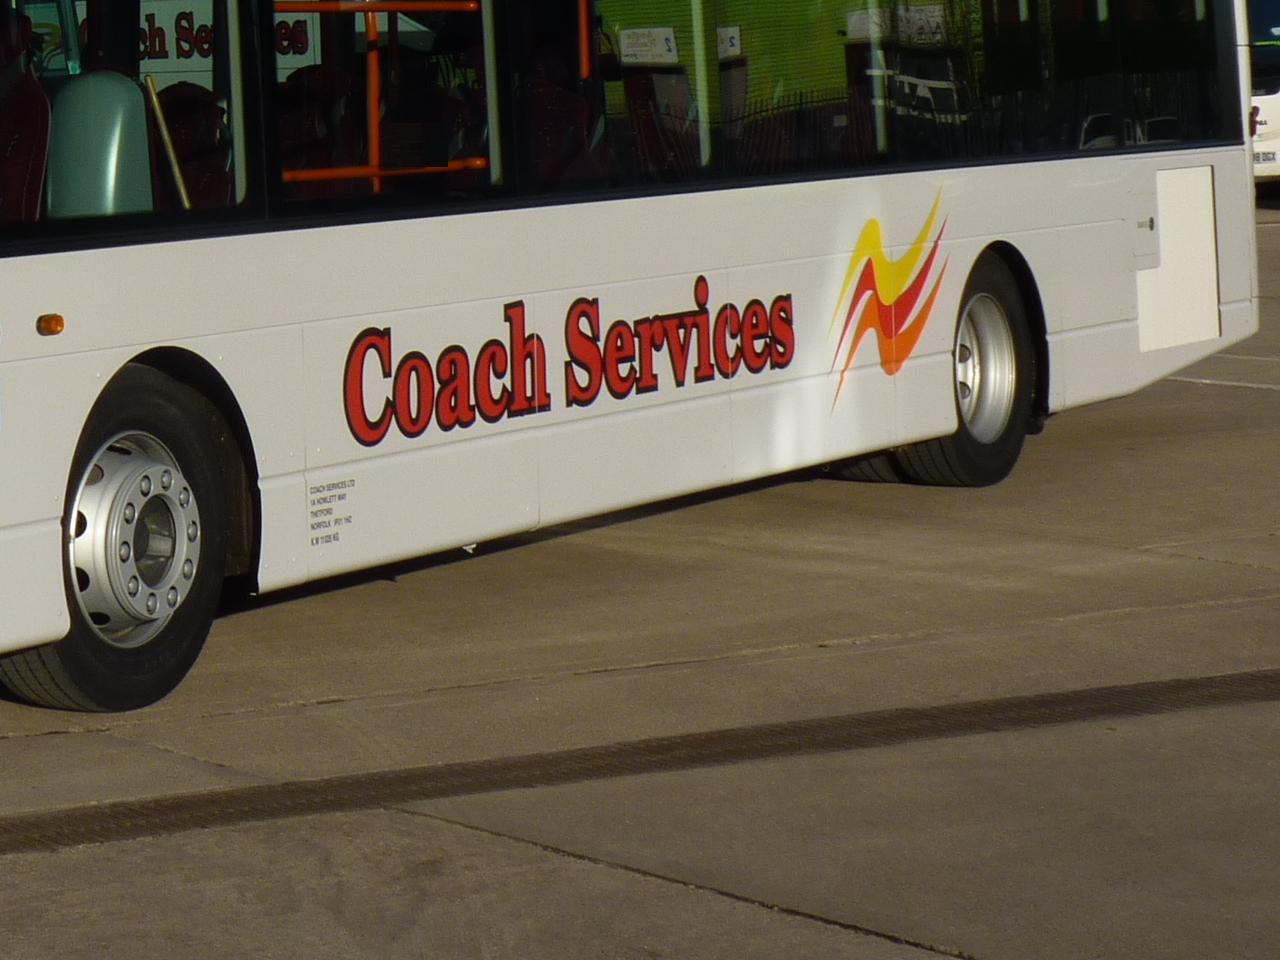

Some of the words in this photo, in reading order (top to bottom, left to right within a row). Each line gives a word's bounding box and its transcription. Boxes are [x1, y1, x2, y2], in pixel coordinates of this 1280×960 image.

[343, 298, 551, 447] Coach
[564, 275, 794, 408] Services
[326, 481, 346, 491] SERVICES
